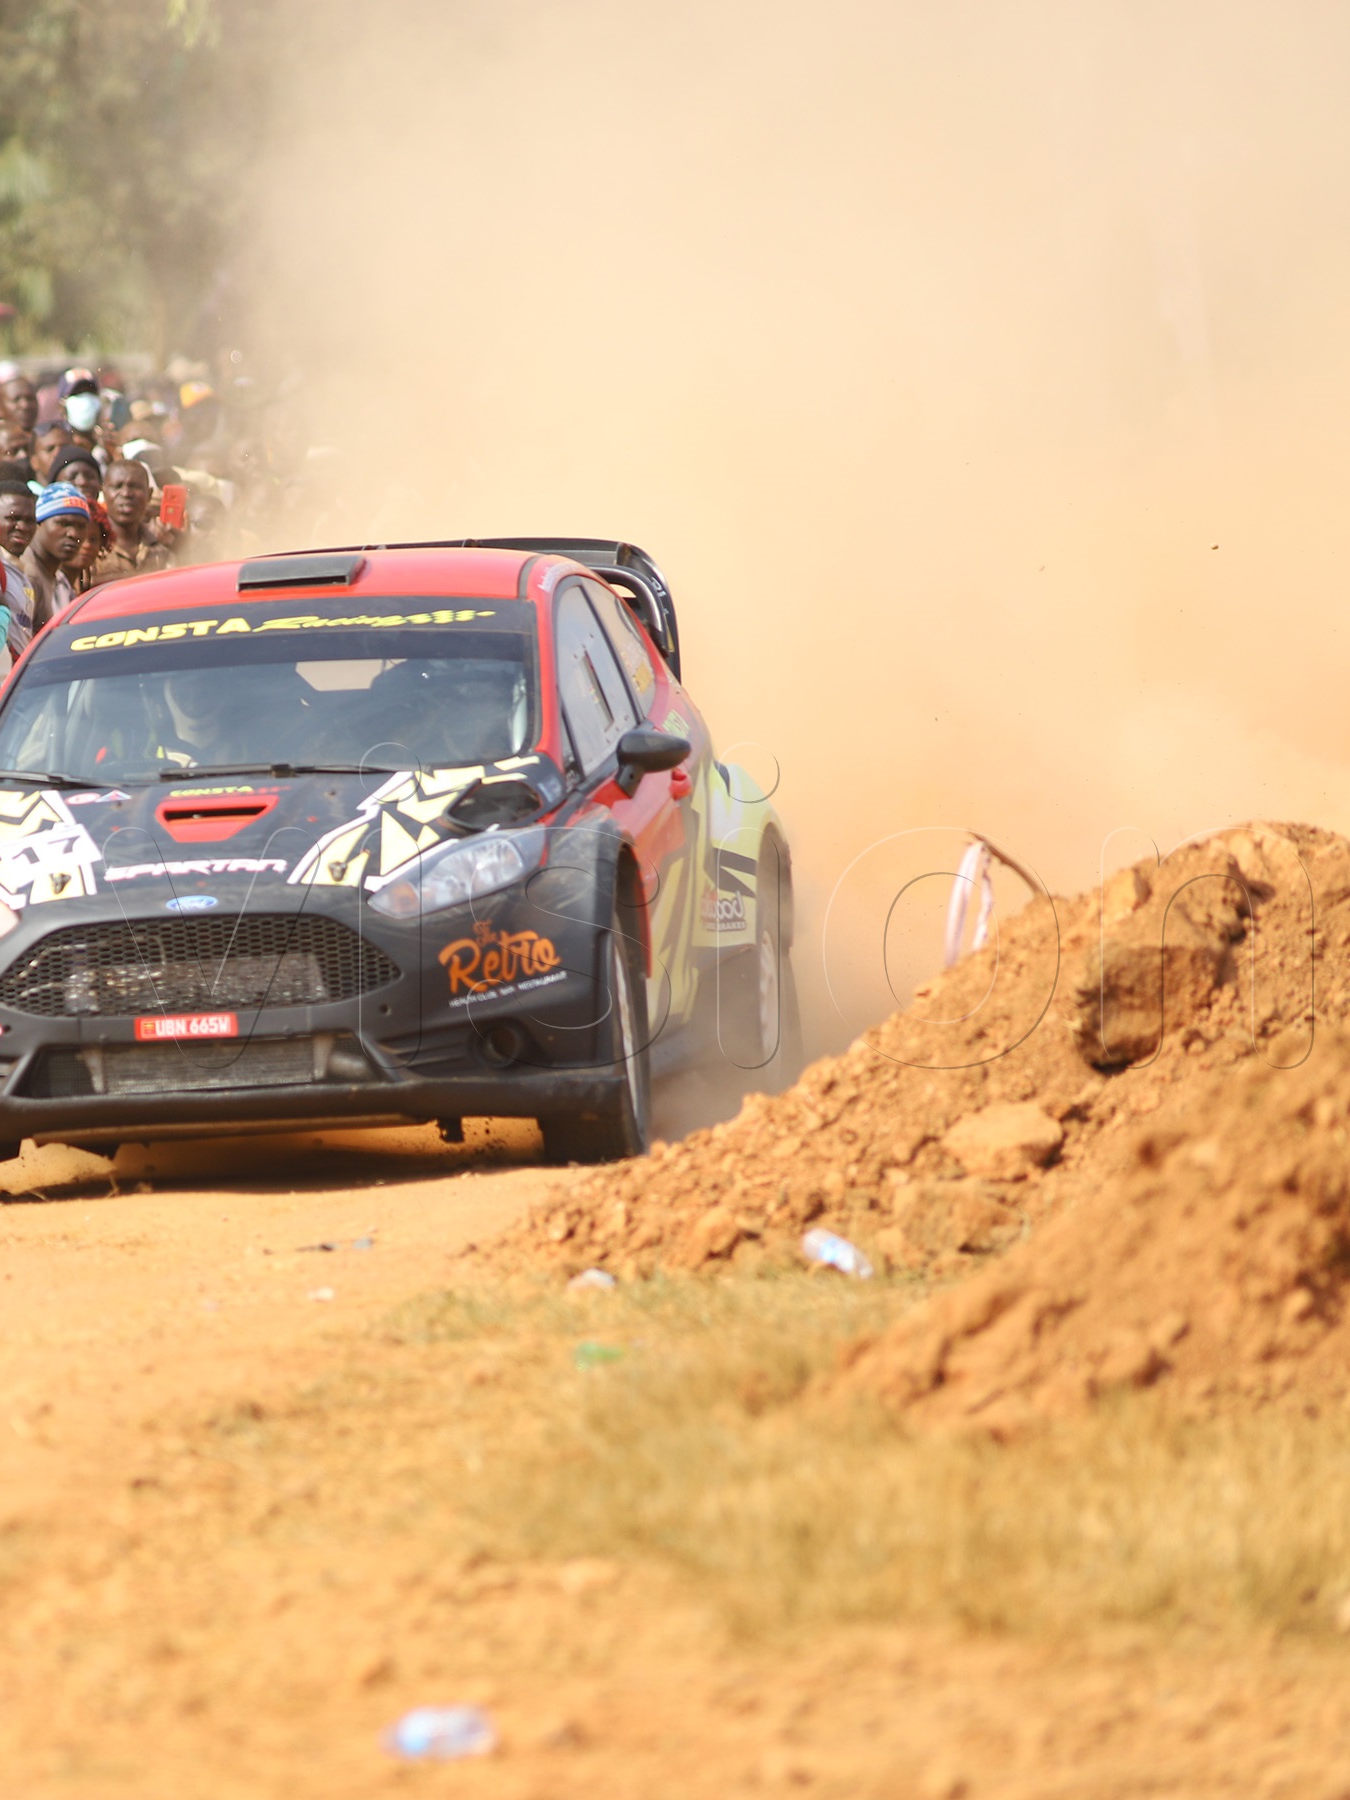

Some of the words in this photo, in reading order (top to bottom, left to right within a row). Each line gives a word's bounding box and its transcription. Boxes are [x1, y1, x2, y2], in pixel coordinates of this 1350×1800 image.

[70, 617, 252, 651] CONSTA
[103, 858, 288, 881] SPARTAN
[171, 896, 214, 911] Ford
[438, 930, 562, 993] Retro
[155, 1018, 187, 1037] UBN
[189, 1015, 231, 1034] 665W
